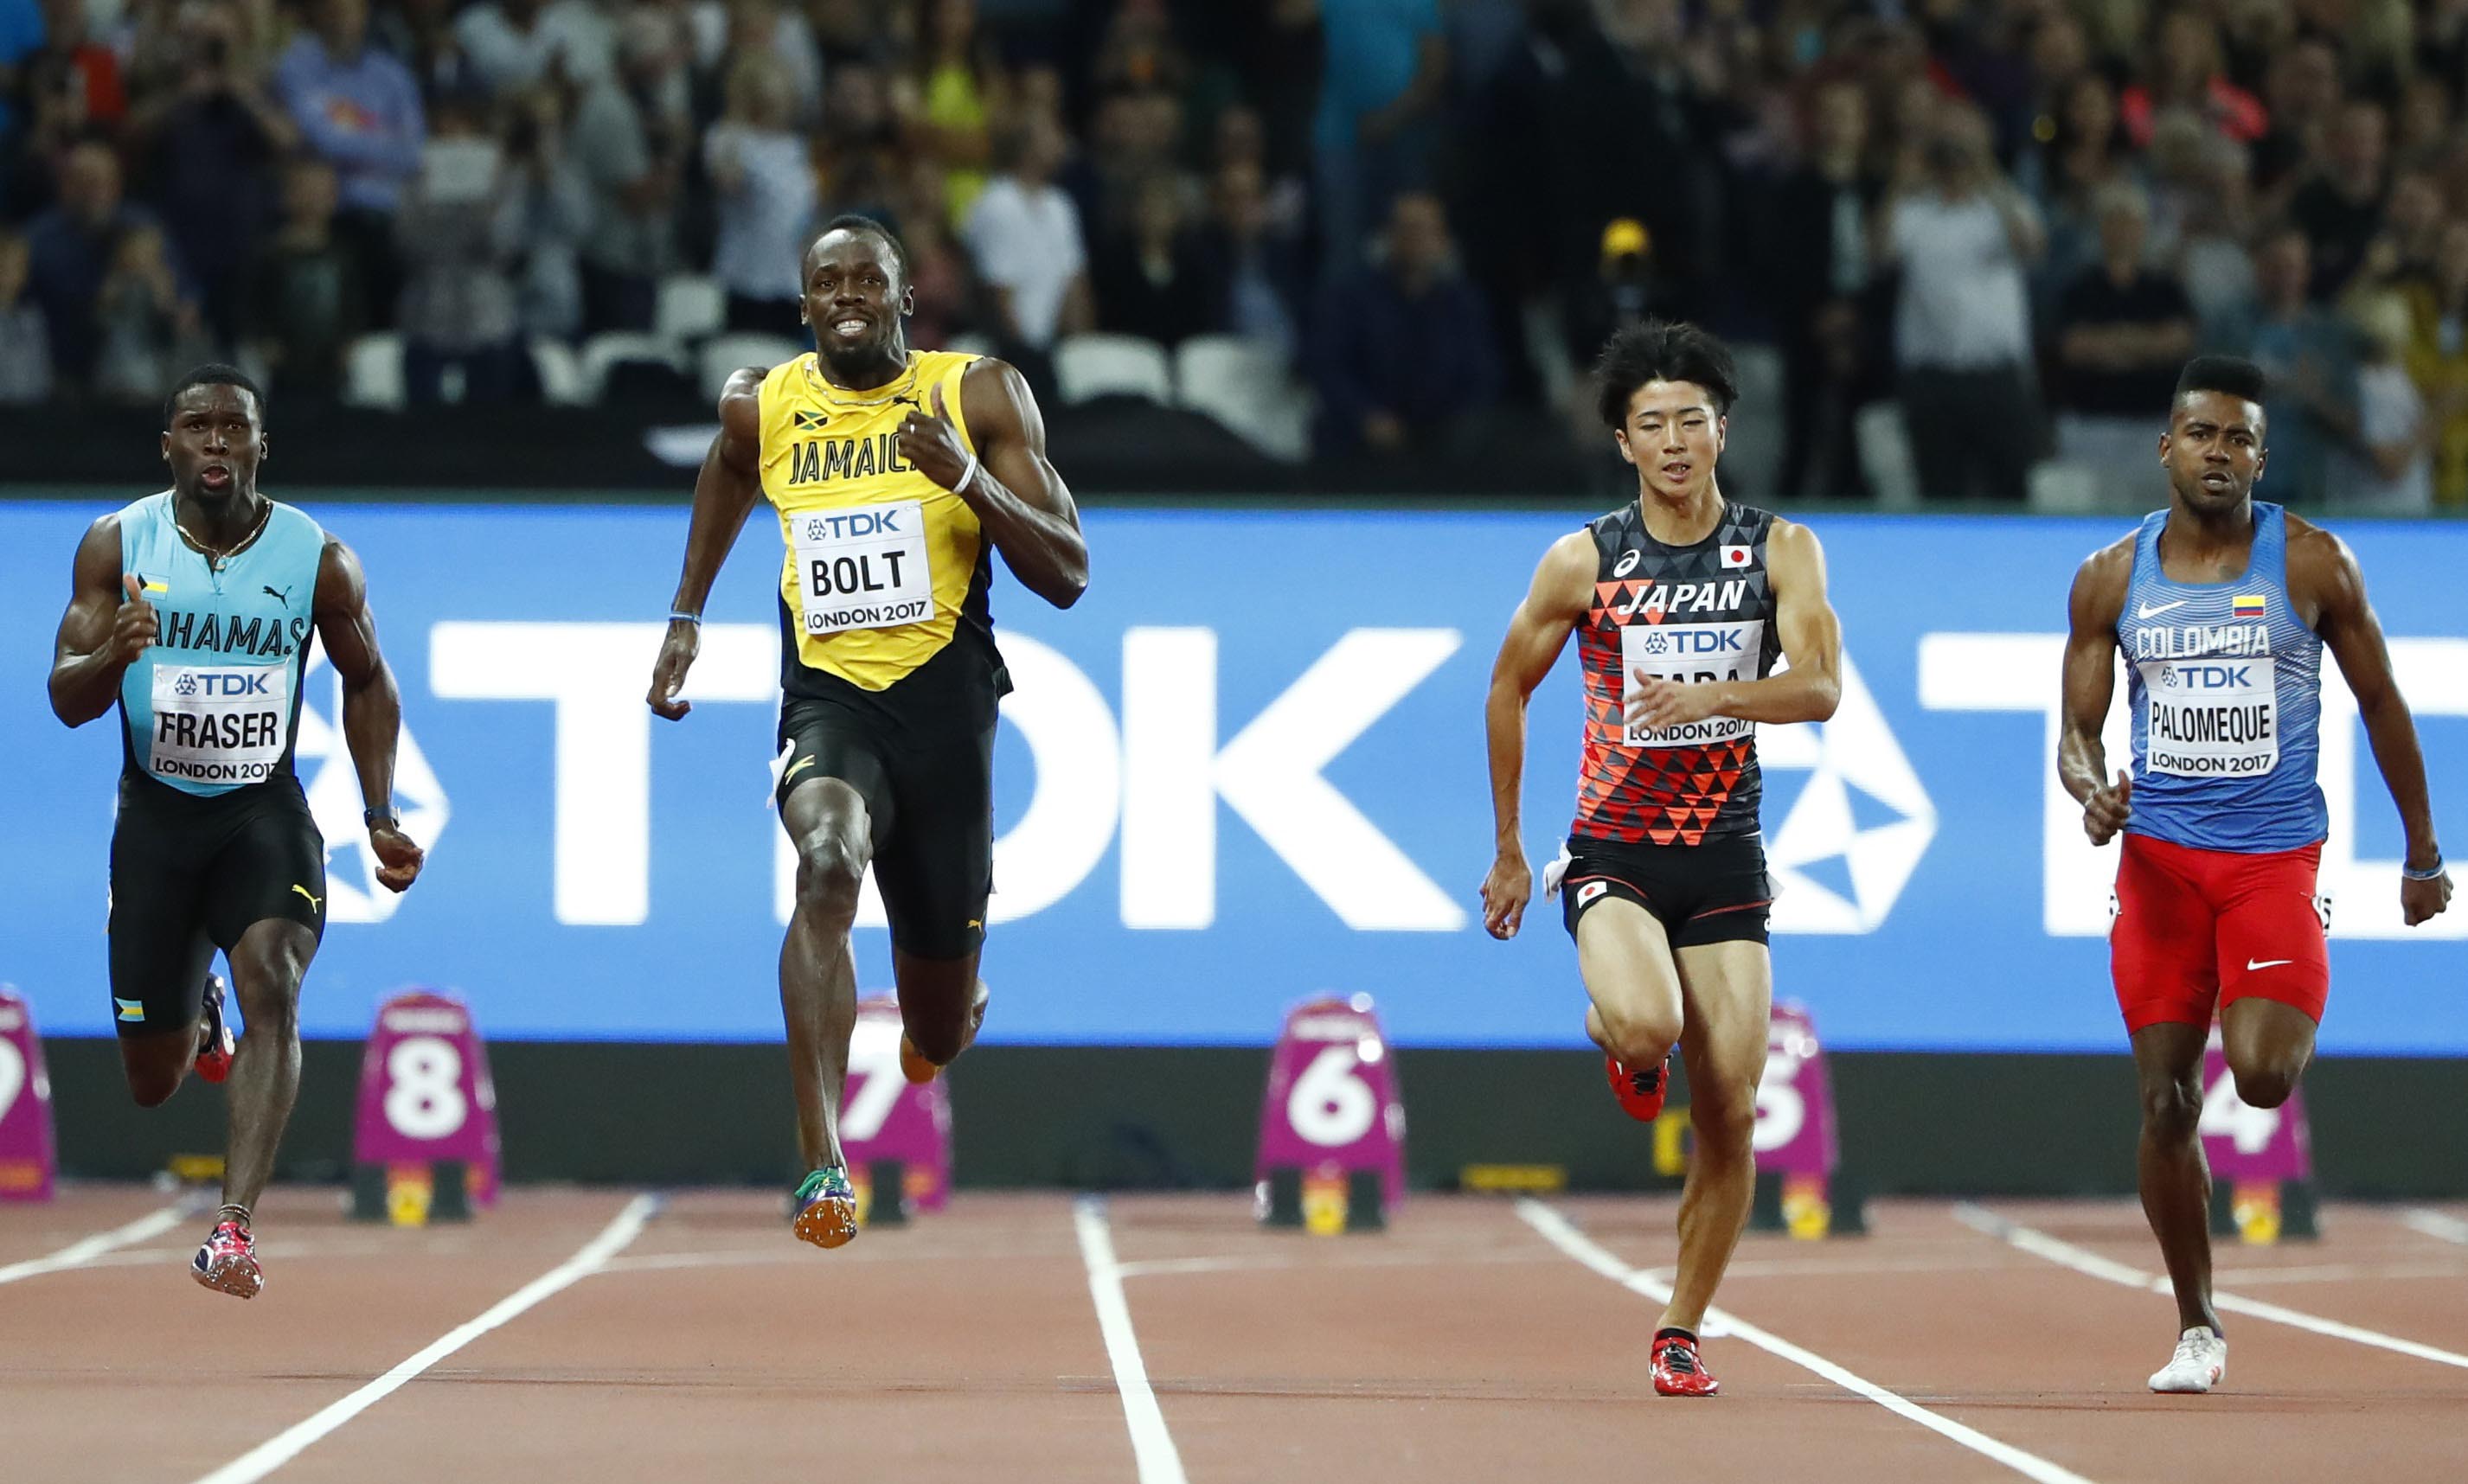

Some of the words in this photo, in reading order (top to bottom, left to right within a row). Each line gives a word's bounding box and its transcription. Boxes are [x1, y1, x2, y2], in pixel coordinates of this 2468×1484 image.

[789, 432, 918, 484] JAMAIC
[825, 509, 900, 538] TDK
[811, 550, 905, 597] BOLT
[808, 608, 881, 630] LONDON
[883, 601, 926, 621] 2017
[1617, 579, 1747, 616] JAPAN
[1668, 630, 1742, 653] TDK
[2136, 625, 2271, 659] COLOMBIA
[197, 673, 269, 695] TDK
[2177, 665, 2252, 688] TDK
[159, 711, 278, 750] FRASER
[1629, 723, 1712, 741] LONDON
[2152, 700, 2271, 745] PALOMEQUE
[156, 758, 237, 778] LONDON
[2152, 752, 2226, 771] LONDON
[2230, 754, 2271, 771] 2017
[384, 1037, 467, 1139] 8
[838, 1041, 907, 1141] 7
[1286, 1045, 1376, 1147] 6
[1752, 1050, 1805, 1151] 5
[2197, 1067, 2280, 1155] 4
